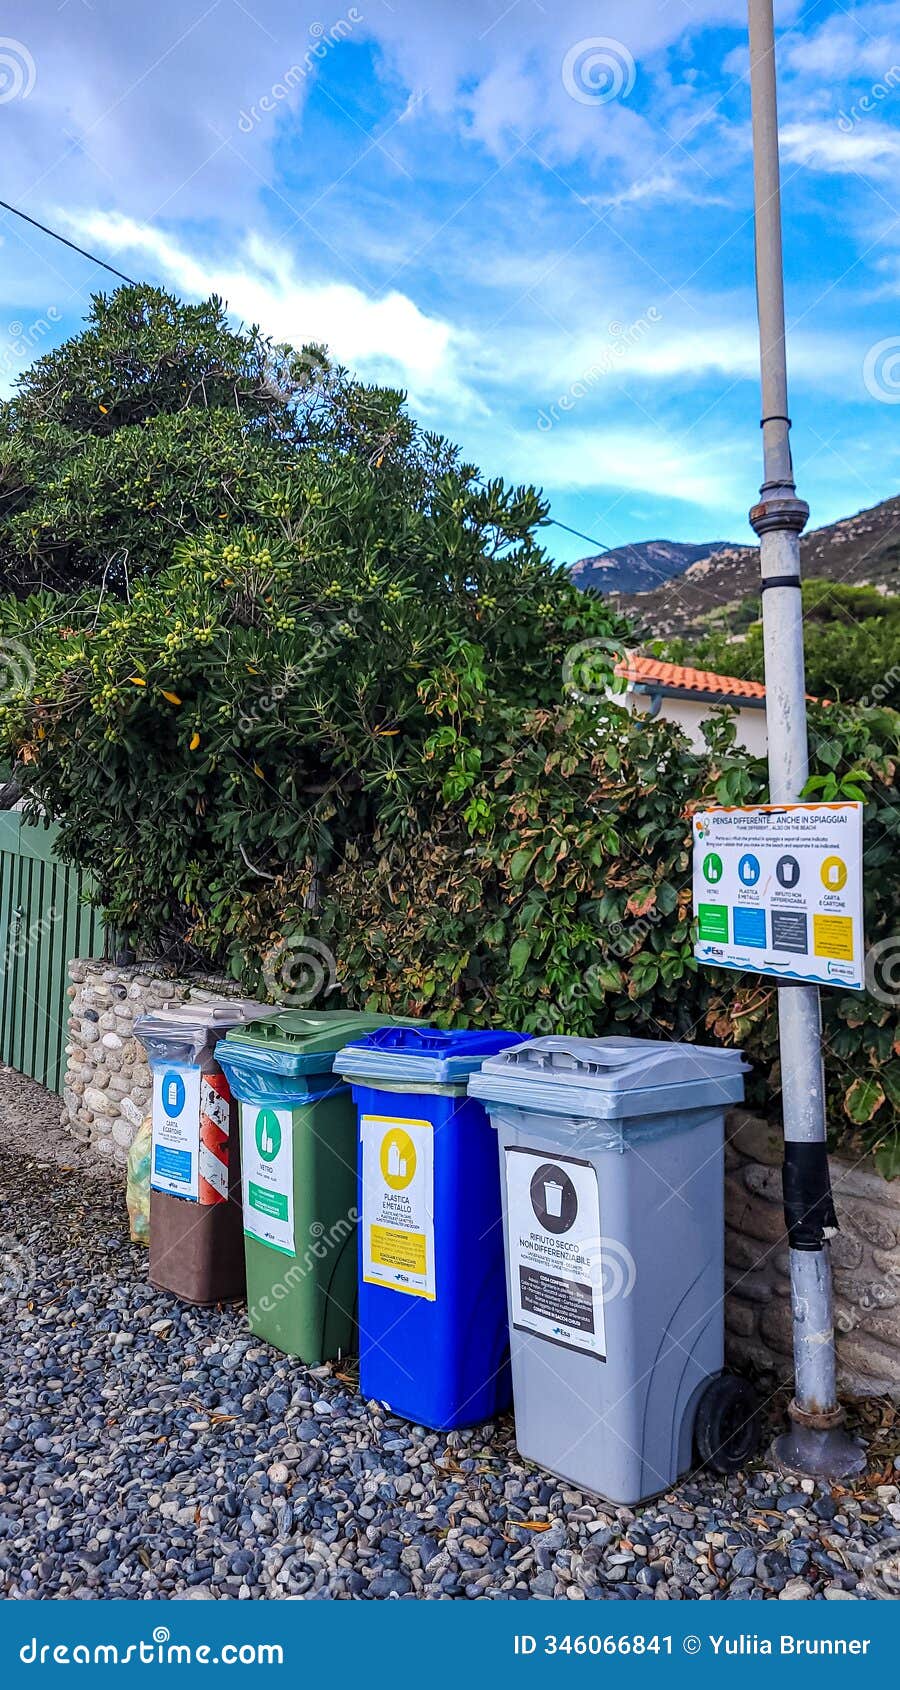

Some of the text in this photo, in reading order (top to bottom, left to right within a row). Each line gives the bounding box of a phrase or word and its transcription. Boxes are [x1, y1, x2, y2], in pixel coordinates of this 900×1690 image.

[712, 817, 733, 825] PENSA
[776, 816, 800, 824] ANCHE
[801, 816, 809, 824] IN
[530, 1232, 580, 1253] RIFIUTO SECCO
[519, 1238, 591, 1267] NON DIFFERENZIABILE
[560, 1328, 571, 1338] Esa
